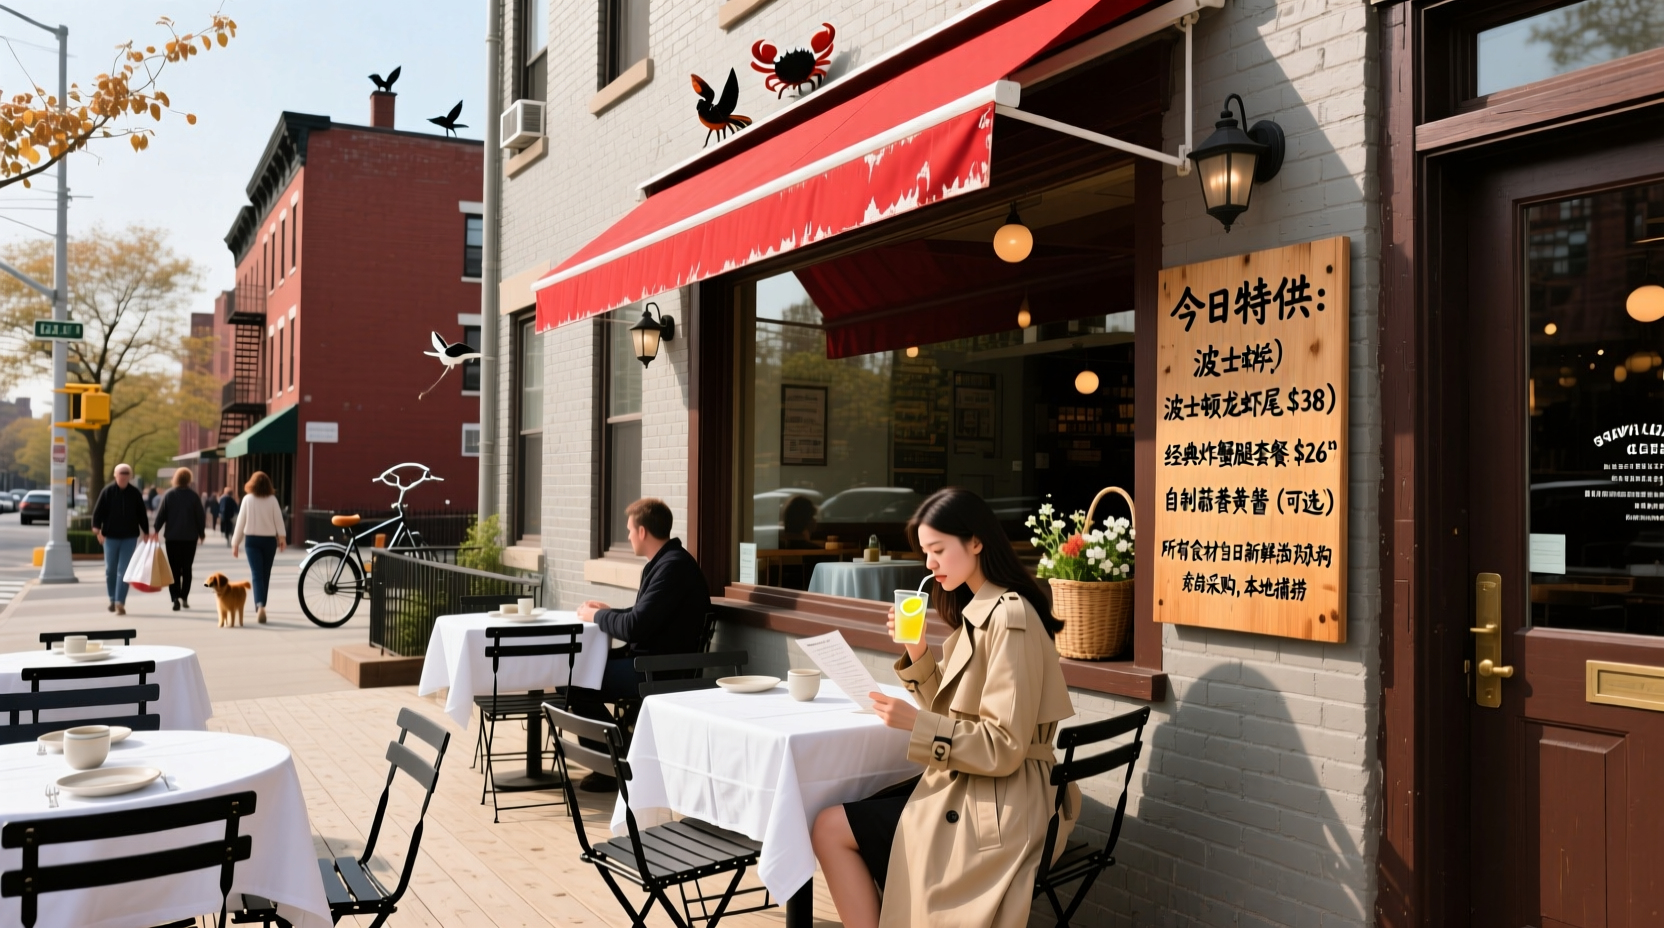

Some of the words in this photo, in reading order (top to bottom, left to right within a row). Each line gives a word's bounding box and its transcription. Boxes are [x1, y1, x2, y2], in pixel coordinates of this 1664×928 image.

[1163, 386, 1284, 421] 波士顿龙虾尾
[1287, 382, 1336, 415] $38)
[1277, 487, 1335, 517] (可选)
